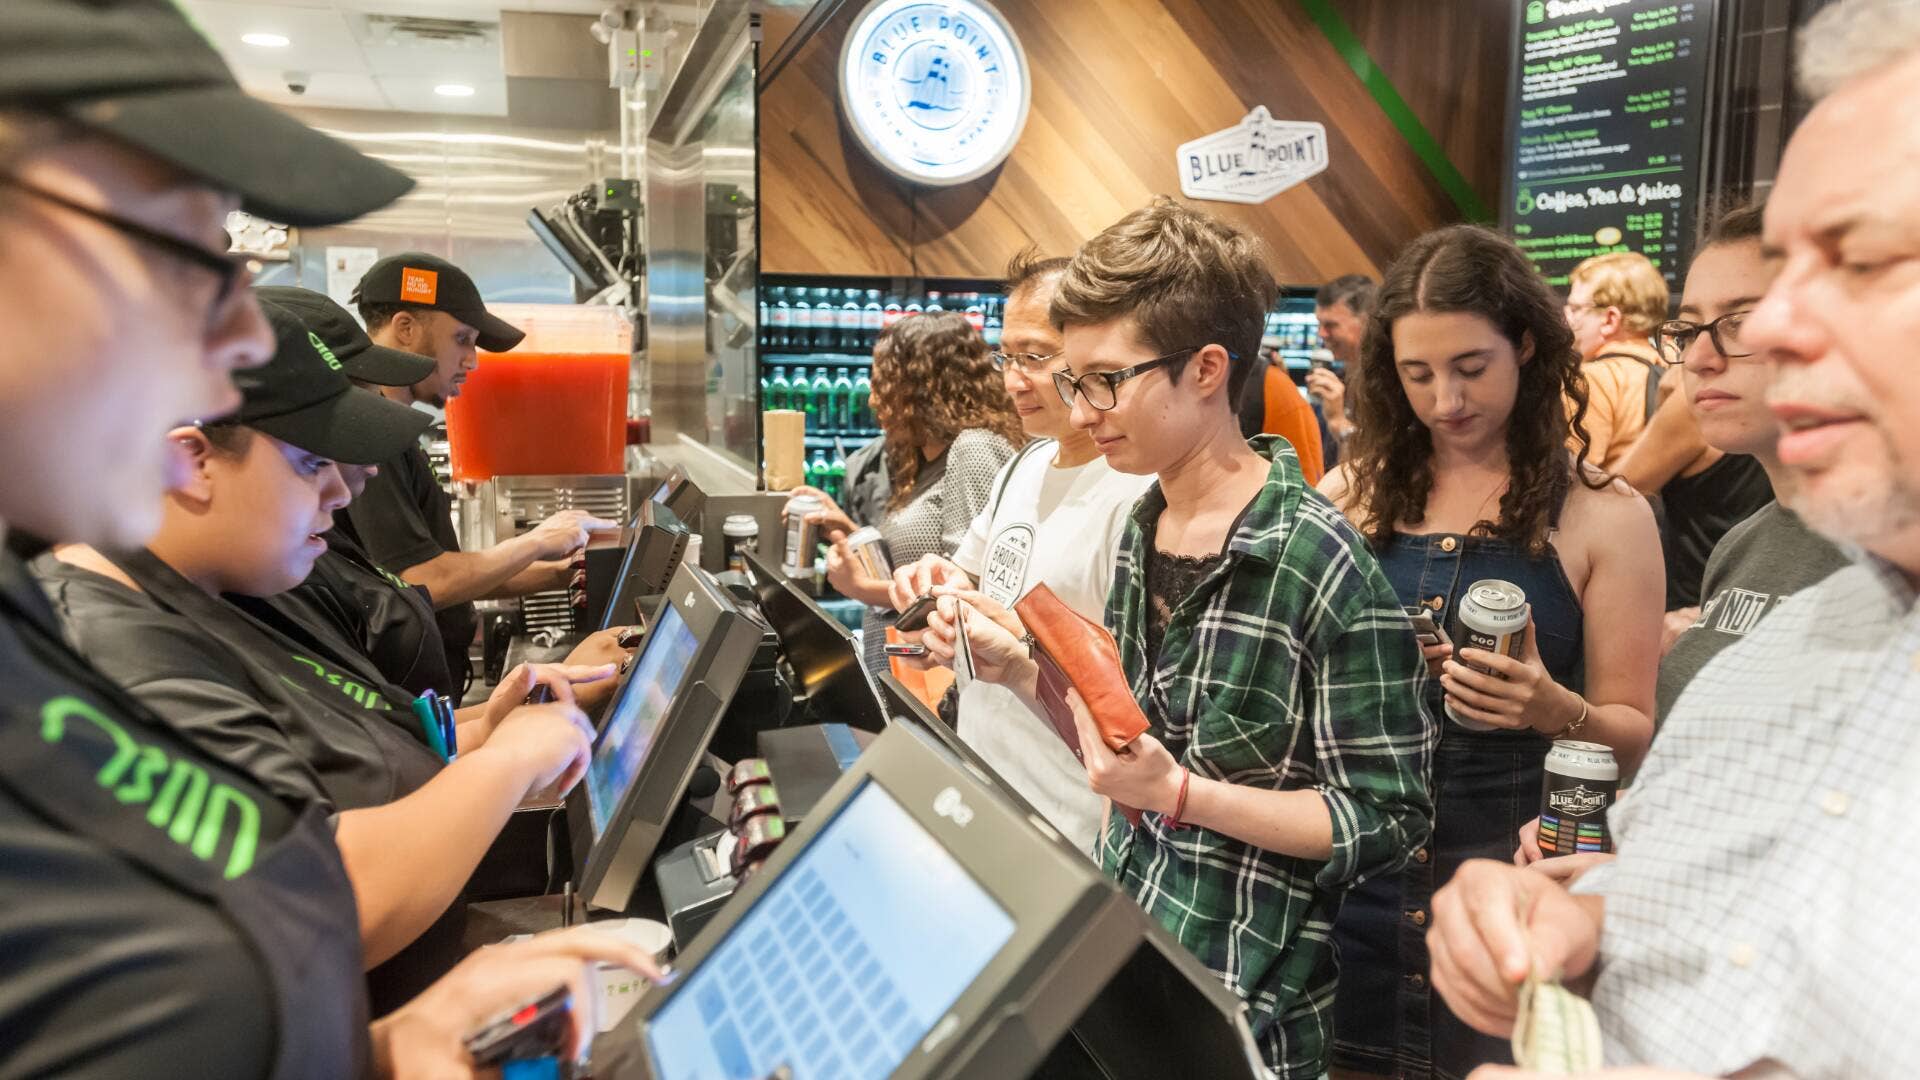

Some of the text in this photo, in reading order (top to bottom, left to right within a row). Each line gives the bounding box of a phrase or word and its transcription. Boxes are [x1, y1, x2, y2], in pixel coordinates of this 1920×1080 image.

[872, 16, 999, 75] BLUE POINT
[1190, 153, 1244, 182] BLUE
[1267, 135, 1315, 163] POINT
[1536, 181, 1682, 213] Coffee, Tea & Juice
[1715, 588, 1770, 635] NOT
[1550, 793, 1605, 806] BLUE POINT
